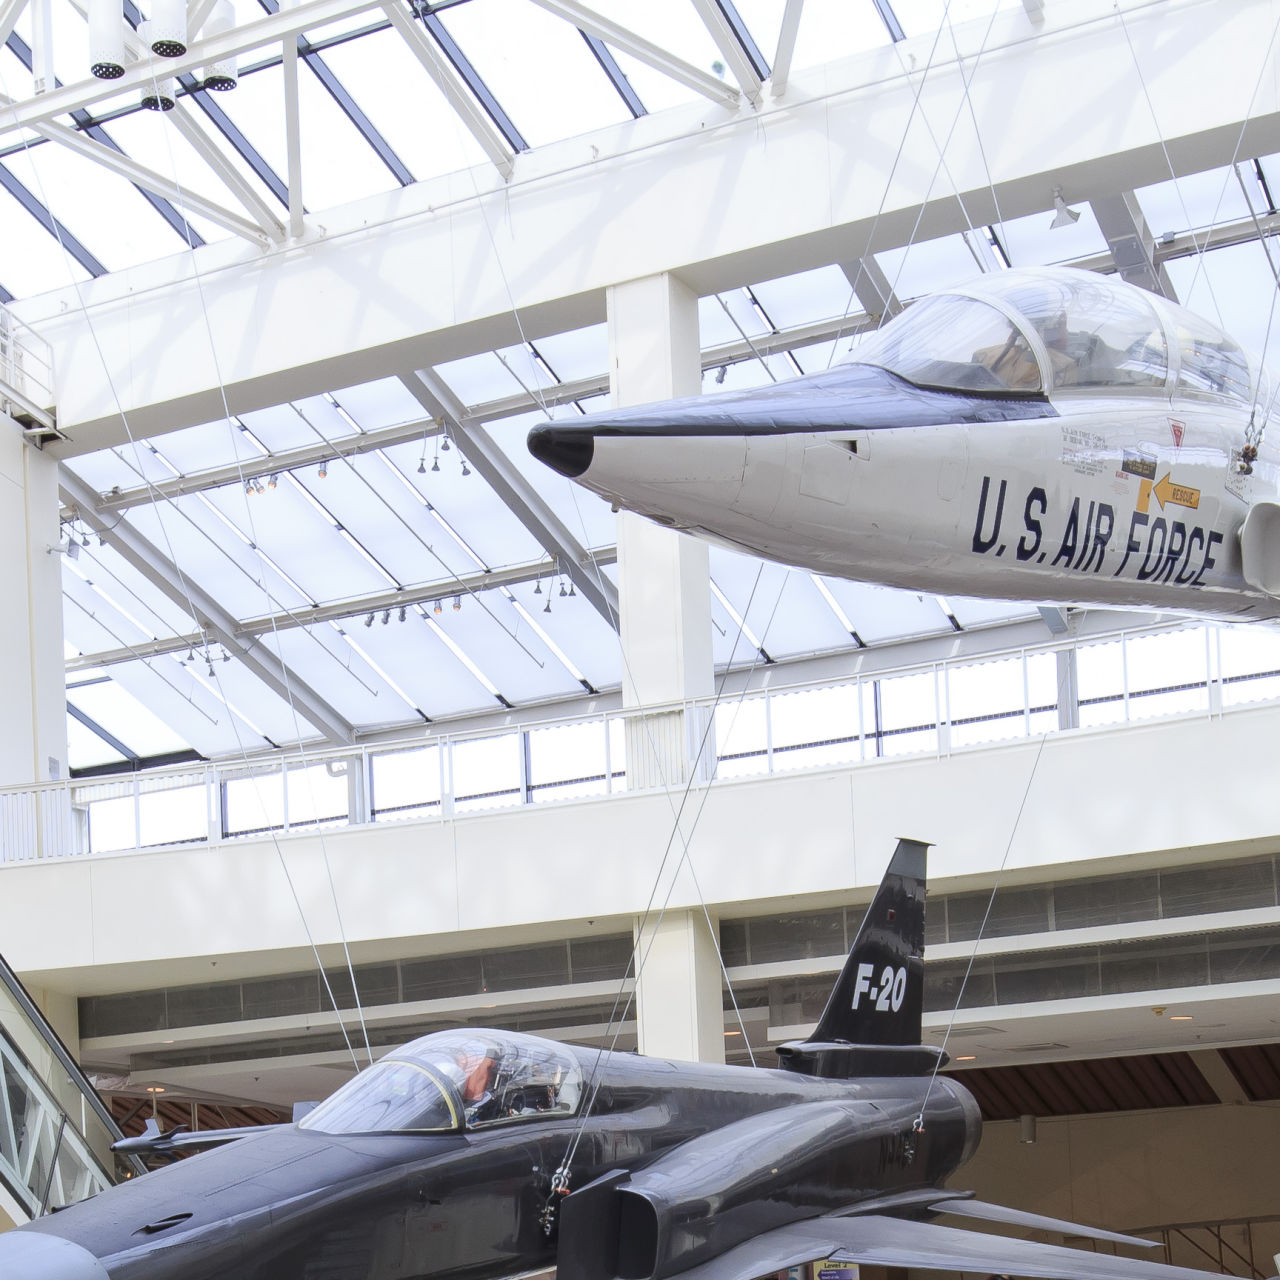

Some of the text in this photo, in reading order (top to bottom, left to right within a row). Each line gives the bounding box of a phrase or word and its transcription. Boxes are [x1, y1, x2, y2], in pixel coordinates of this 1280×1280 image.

[1171, 487, 1195, 505] RESCUE
[972, 476, 1224, 586] U.S. AIR FORCE
[851, 962, 907, 1013] F-20
